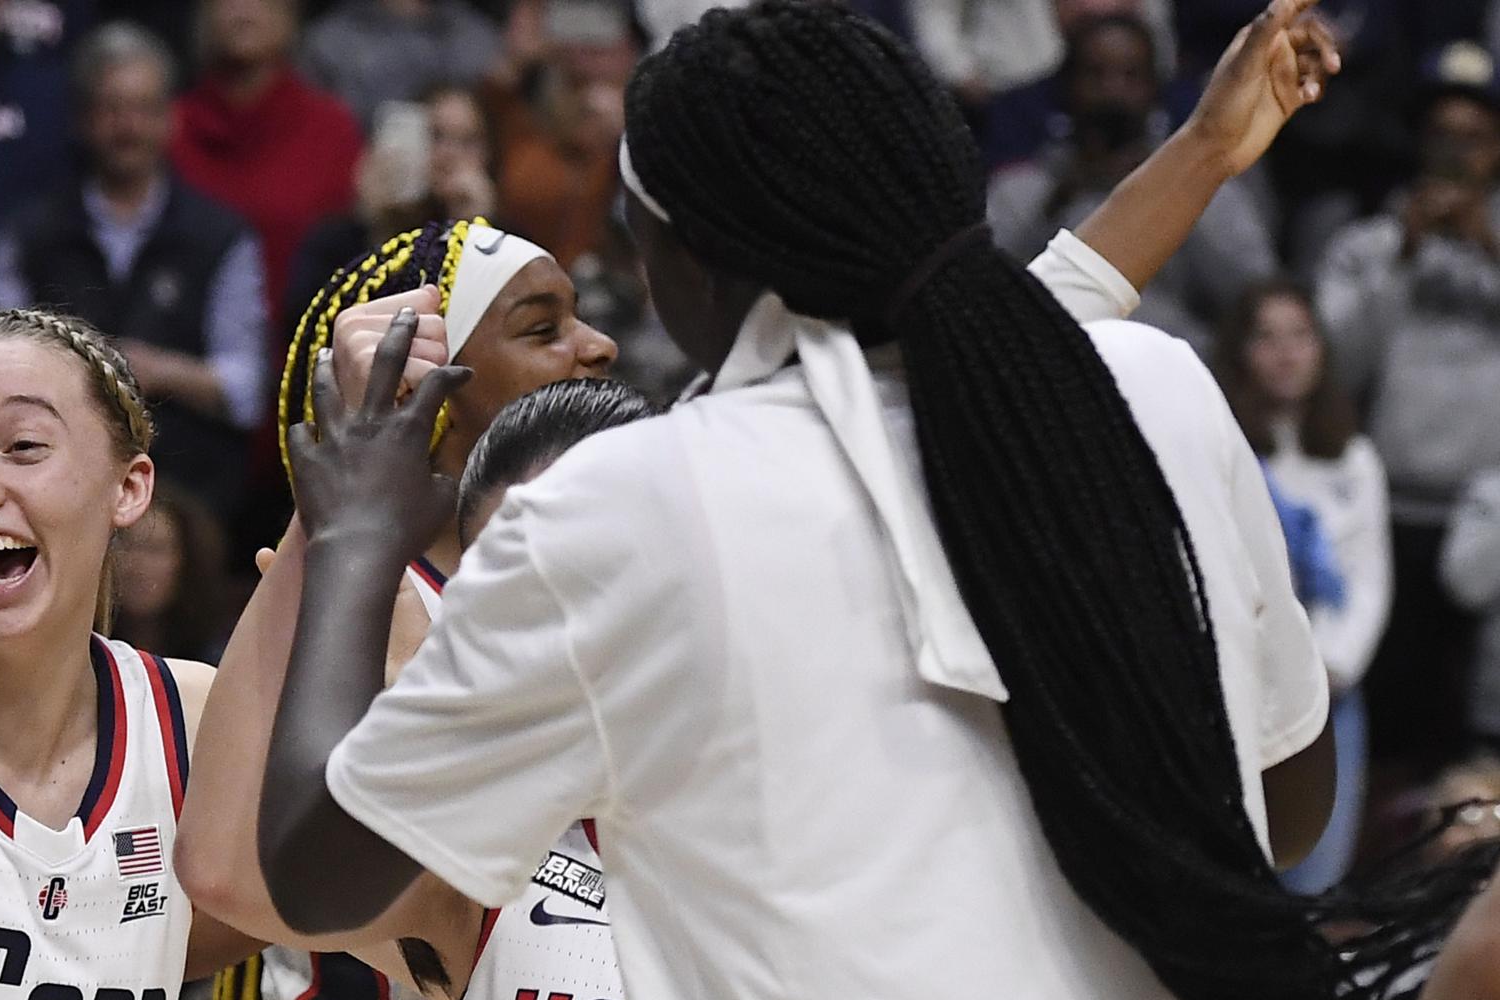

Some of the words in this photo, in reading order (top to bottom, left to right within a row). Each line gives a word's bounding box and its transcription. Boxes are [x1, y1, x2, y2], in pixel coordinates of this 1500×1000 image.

[544, 855, 586, 882] BE
[128, 882, 159, 900] BIG
[534, 867, 604, 904] HANGE
[123, 896, 168, 916] EAST
